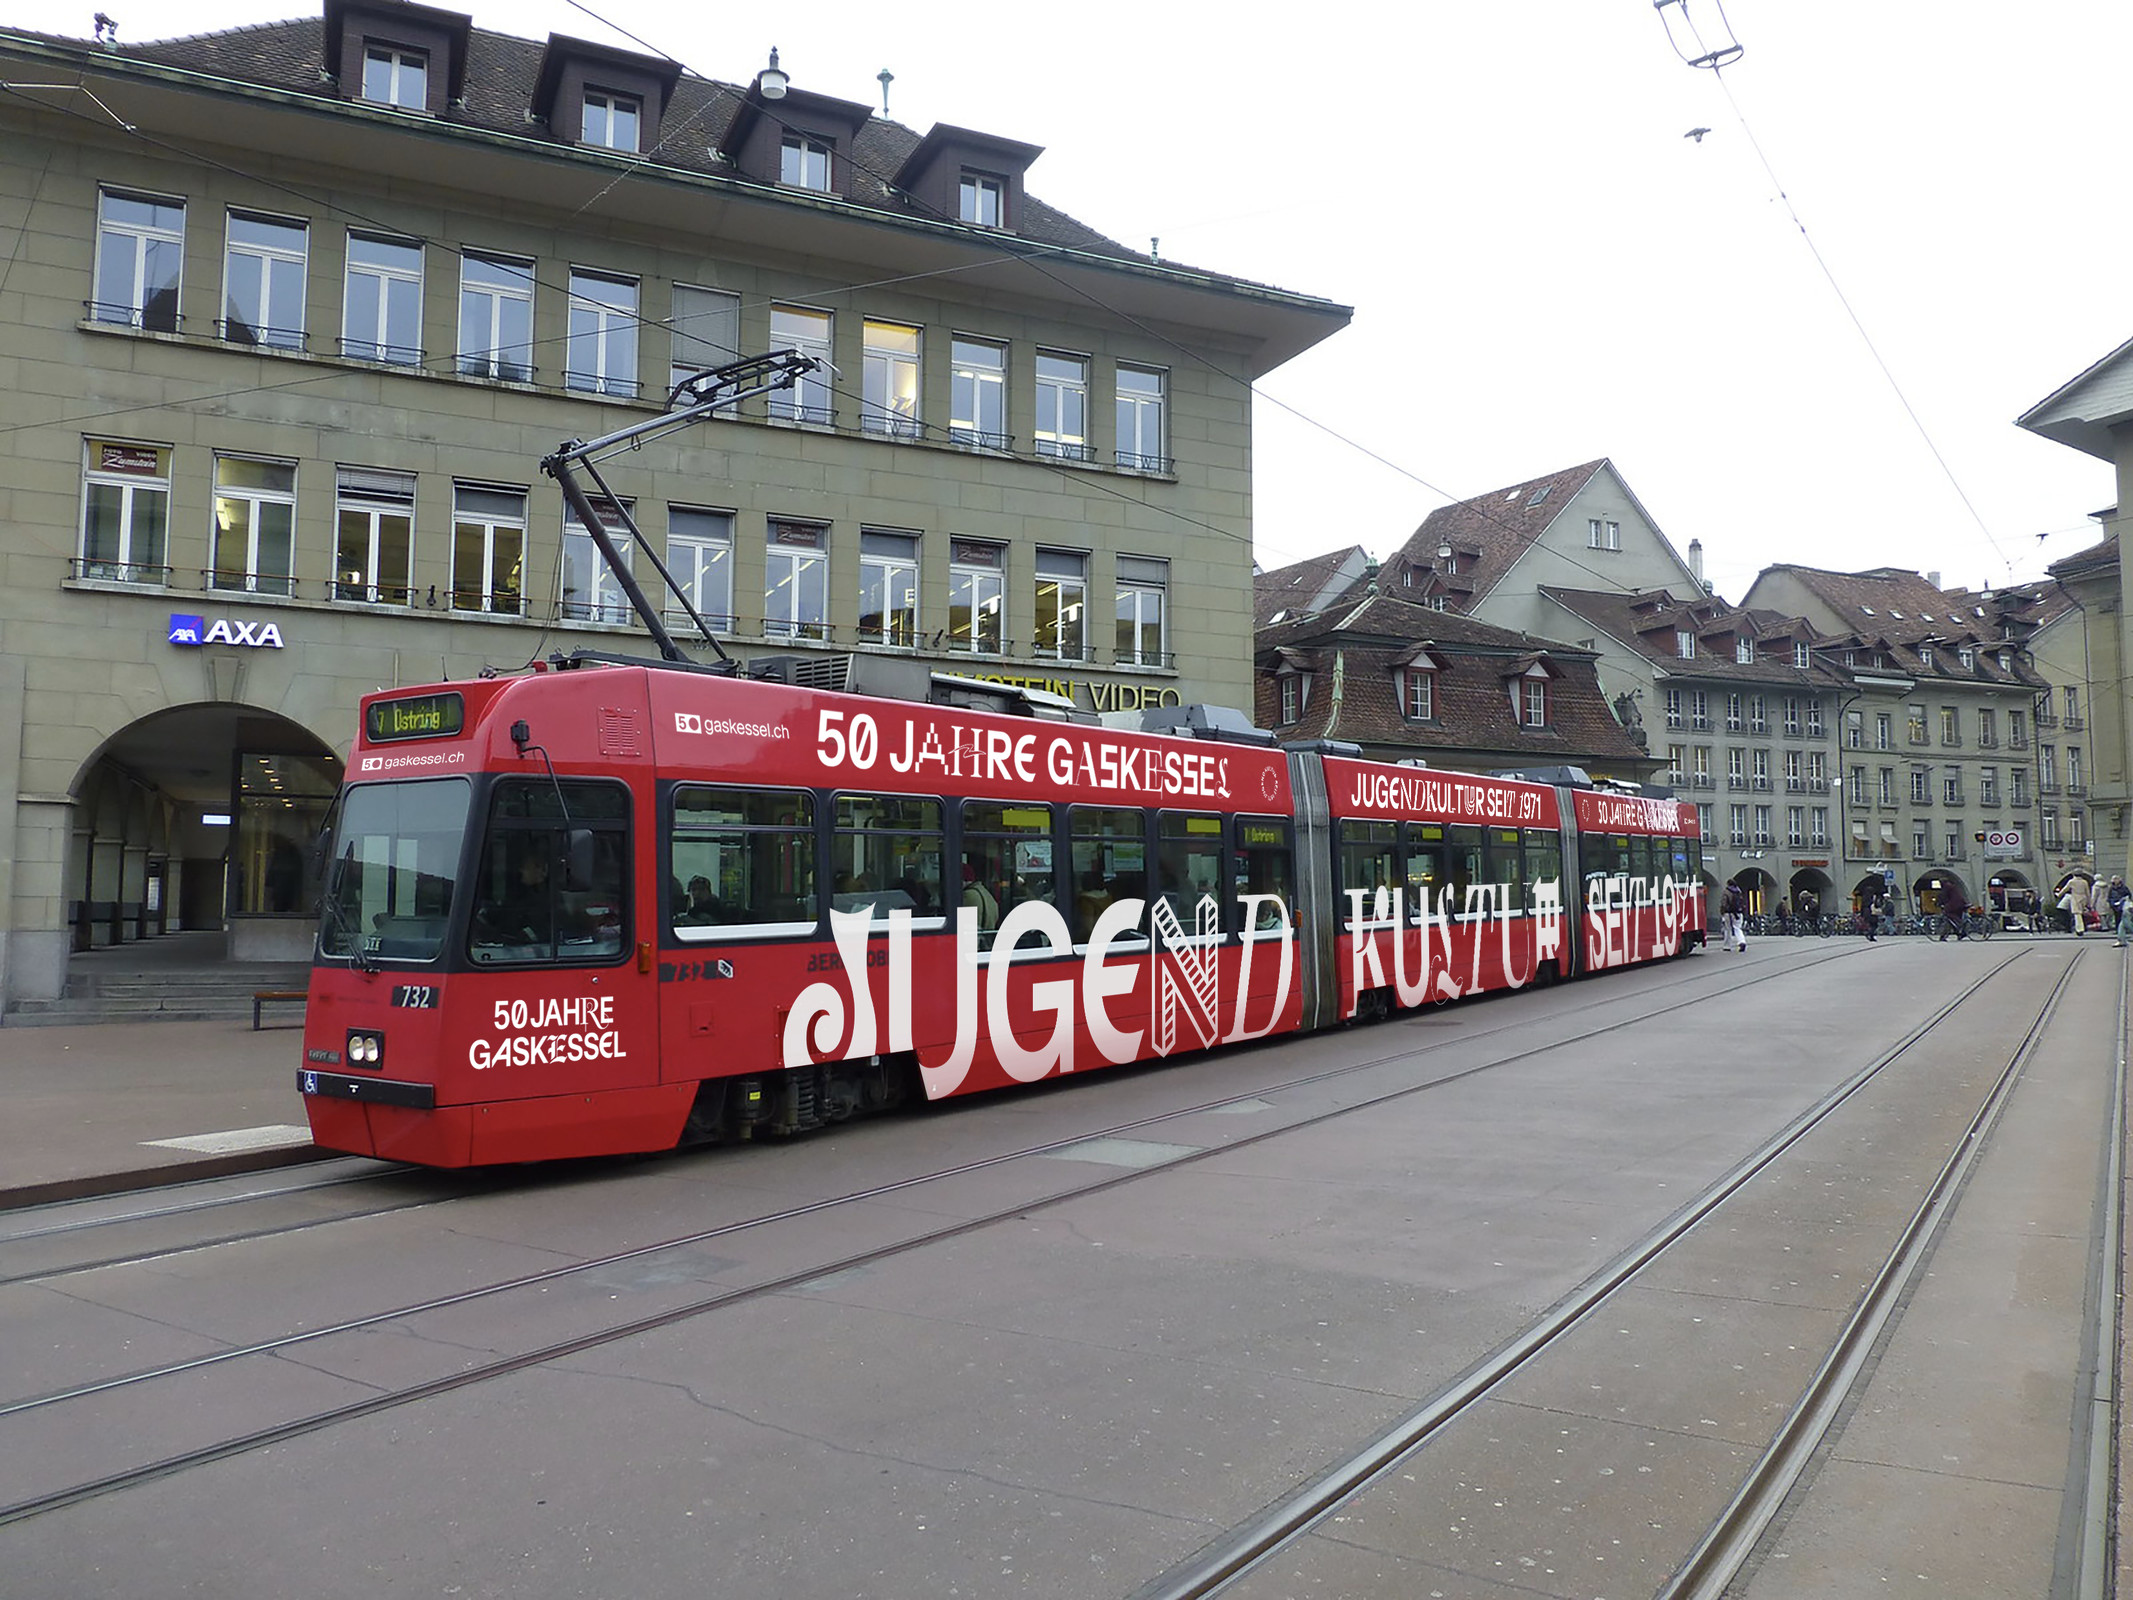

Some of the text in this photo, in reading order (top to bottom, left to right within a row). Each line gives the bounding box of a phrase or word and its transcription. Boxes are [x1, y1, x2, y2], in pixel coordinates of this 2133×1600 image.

[102, 453, 156, 468] Zumstein
[169, 629, 197, 641] AXA
[203, 619, 284, 647] AXA
[1088, 682, 1181, 710] VIDEO
[378, 706, 440, 734] 7 Ostring
[704, 718, 790, 739] gaskessel.ch
[384, 752, 465, 770] gaskessel.ch
[817, 709, 878, 769] 50
[890, 720, 1037, 782] JAHRE
[1047, 737, 1232, 799] GASKESSEL
[1351, 772, 1541, 820] JUGENDKULTUR SEIT 1971
[1609, 803, 1636, 826] JAHRE
[401, 986, 430, 1008] 732
[783, 893, 1294, 1100] JUGEND
[1344, 876, 1560, 1017] KULTUR
[1588, 877, 1647, 970] SEIT
[494, 996, 614, 1032] 50 JAHRE
[469, 1031, 626, 1070] GASKESSEL
